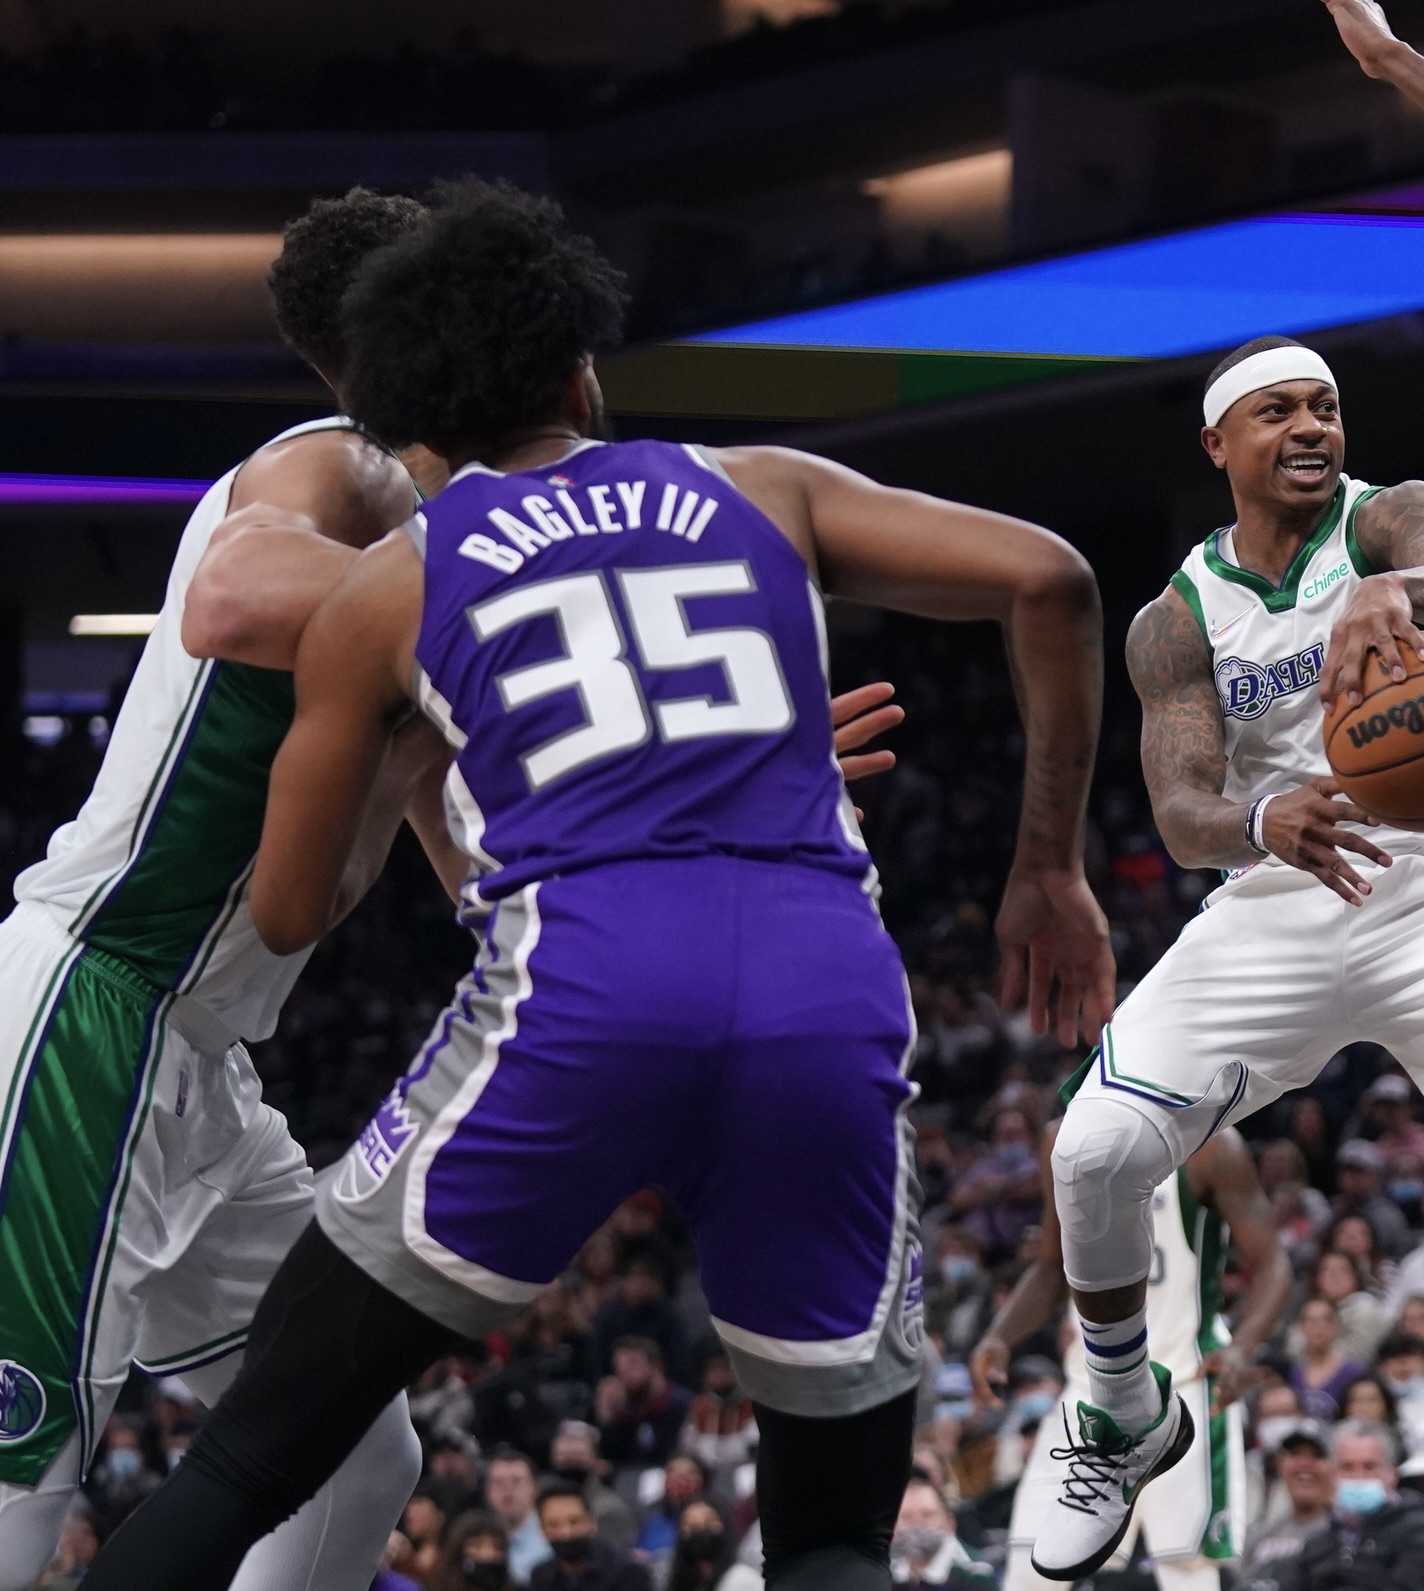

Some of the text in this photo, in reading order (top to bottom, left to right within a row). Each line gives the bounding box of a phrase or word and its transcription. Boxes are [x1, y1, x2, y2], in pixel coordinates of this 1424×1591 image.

[458, 480, 719, 575] BAGLEY III
[1303, 562, 1350, 599] chime
[466, 559, 796, 794] 35
[1226, 642, 1325, 710] DALL
